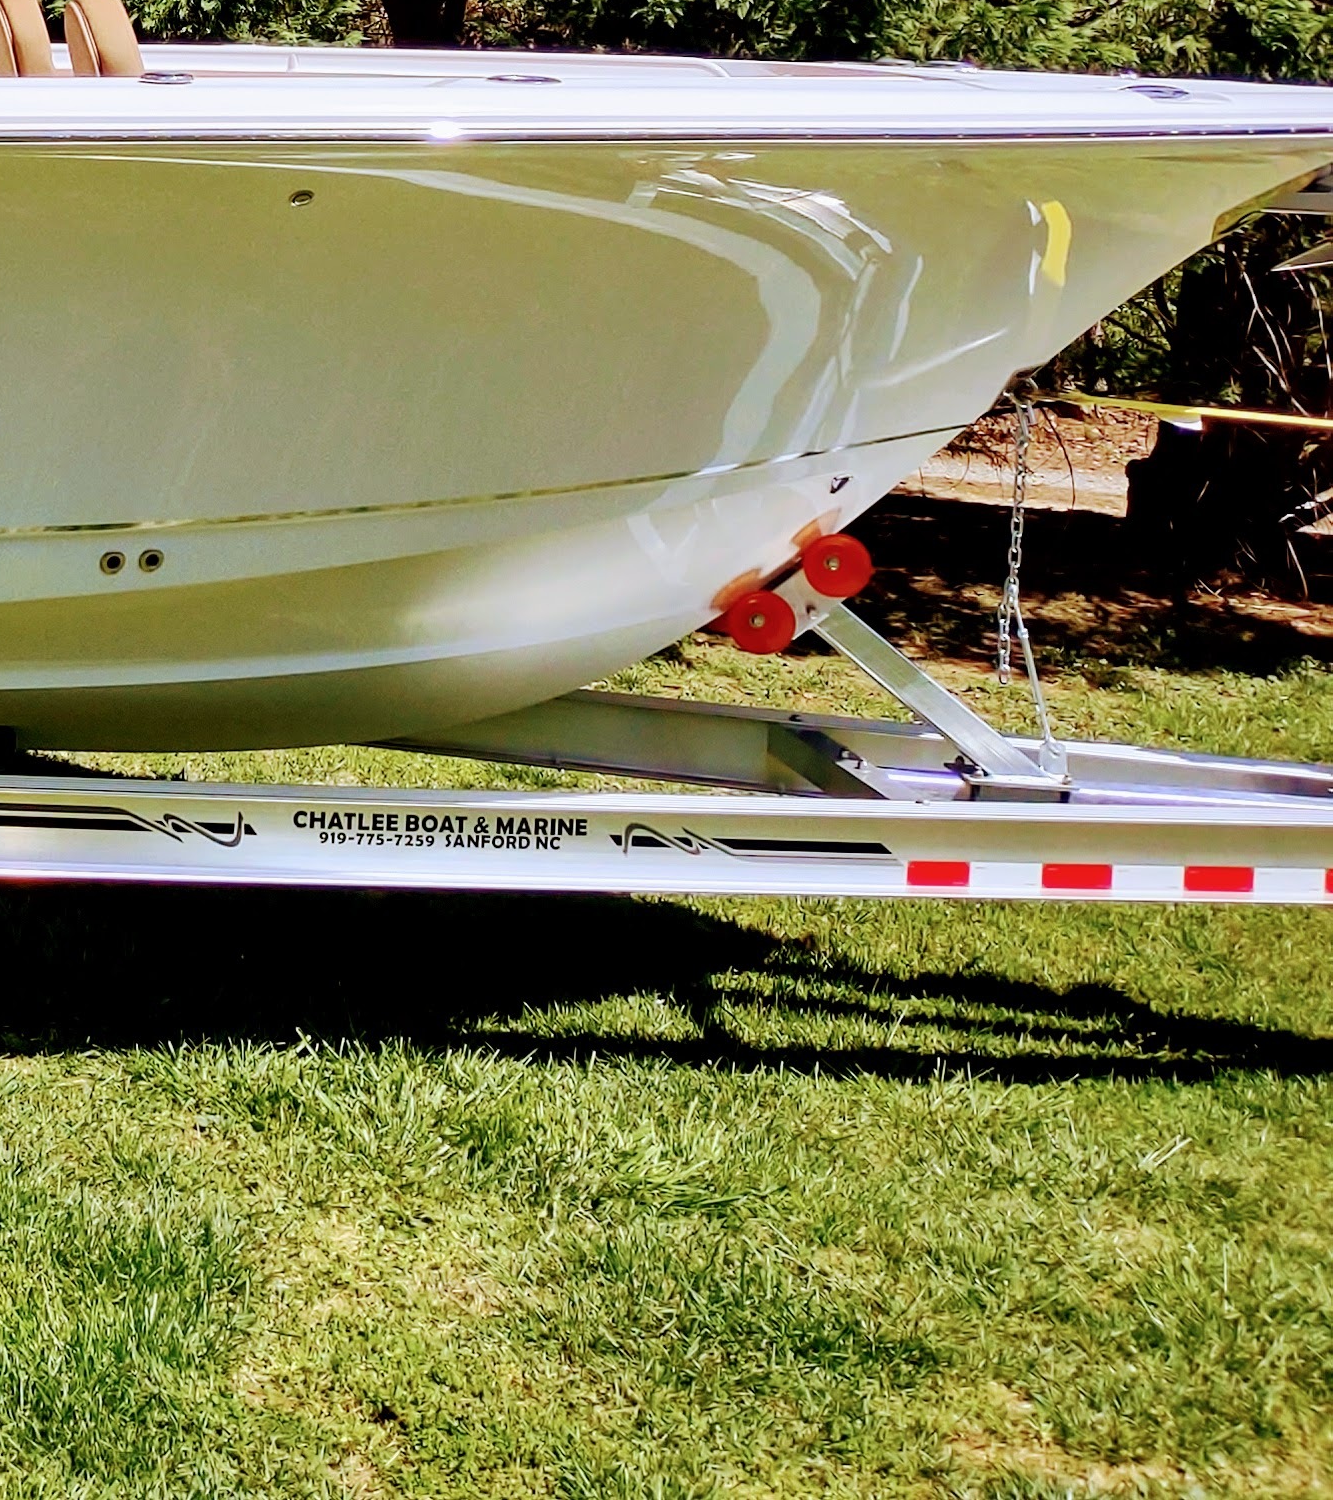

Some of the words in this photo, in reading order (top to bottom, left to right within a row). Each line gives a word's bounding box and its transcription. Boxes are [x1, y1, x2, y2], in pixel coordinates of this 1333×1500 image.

[292, 810, 399, 832] CHATLEE
[405, 814, 468, 834] BOAT
[473, 816, 489, 834] &
[496, 816, 588, 836] MARINE
[319, 831, 435, 847] 919-775-7259
[445, 834, 531, 849] SANFORD
[536, 836, 561, 850] NC
